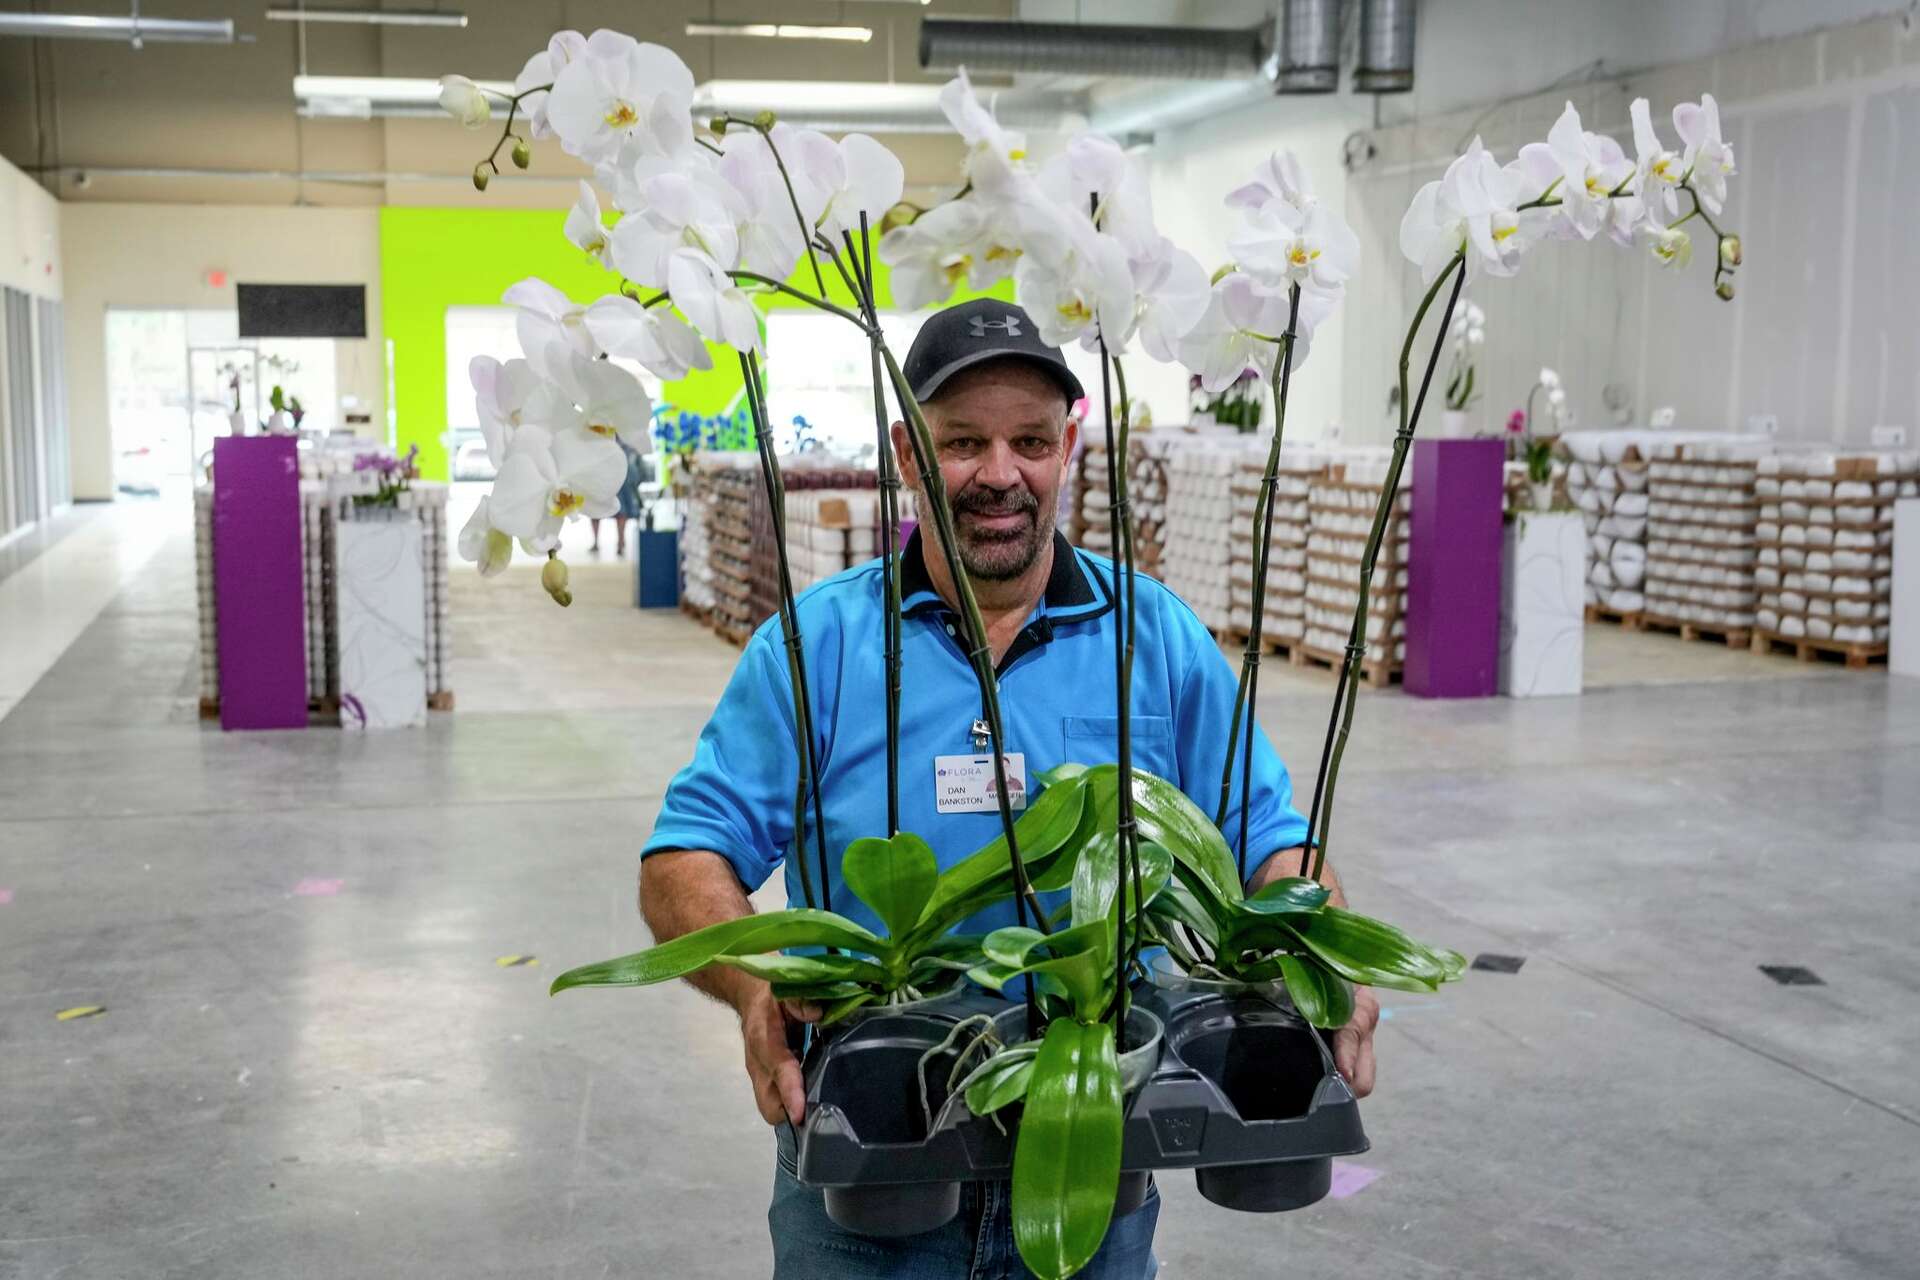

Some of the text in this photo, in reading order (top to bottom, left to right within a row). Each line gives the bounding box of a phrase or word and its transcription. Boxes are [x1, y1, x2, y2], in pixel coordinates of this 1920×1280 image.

[947, 767, 982, 777] FLORA
[947, 786, 966, 795] DAN
[938, 796, 983, 806] BANKSTON
